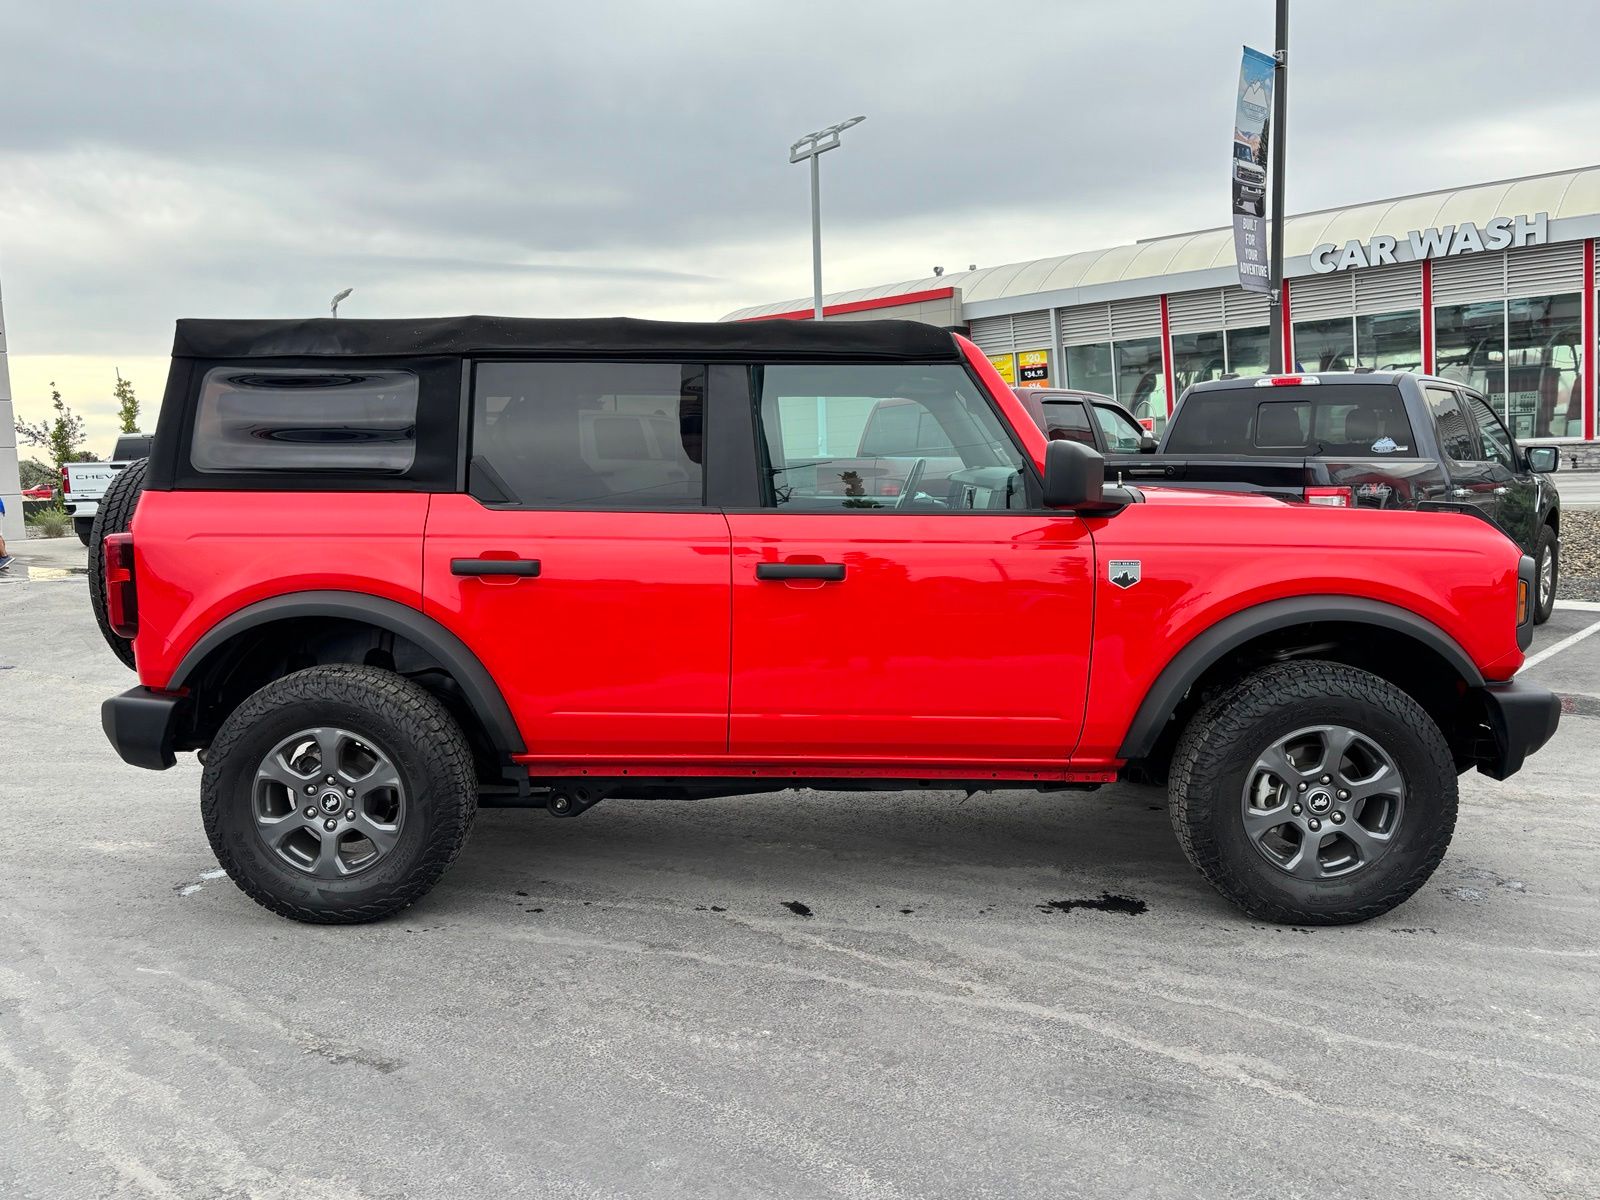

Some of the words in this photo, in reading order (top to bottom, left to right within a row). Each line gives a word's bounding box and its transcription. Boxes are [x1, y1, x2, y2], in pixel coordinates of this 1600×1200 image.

[1242, 217, 1258, 231] BUILT
[1245, 233, 1256, 246] FOR
[1310, 235, 1399, 274] CAR
[1407, 211, 1549, 260] WASH
[1244, 247, 1258, 261] YOUR
[1240, 261, 1268, 278] ADVENTURE
